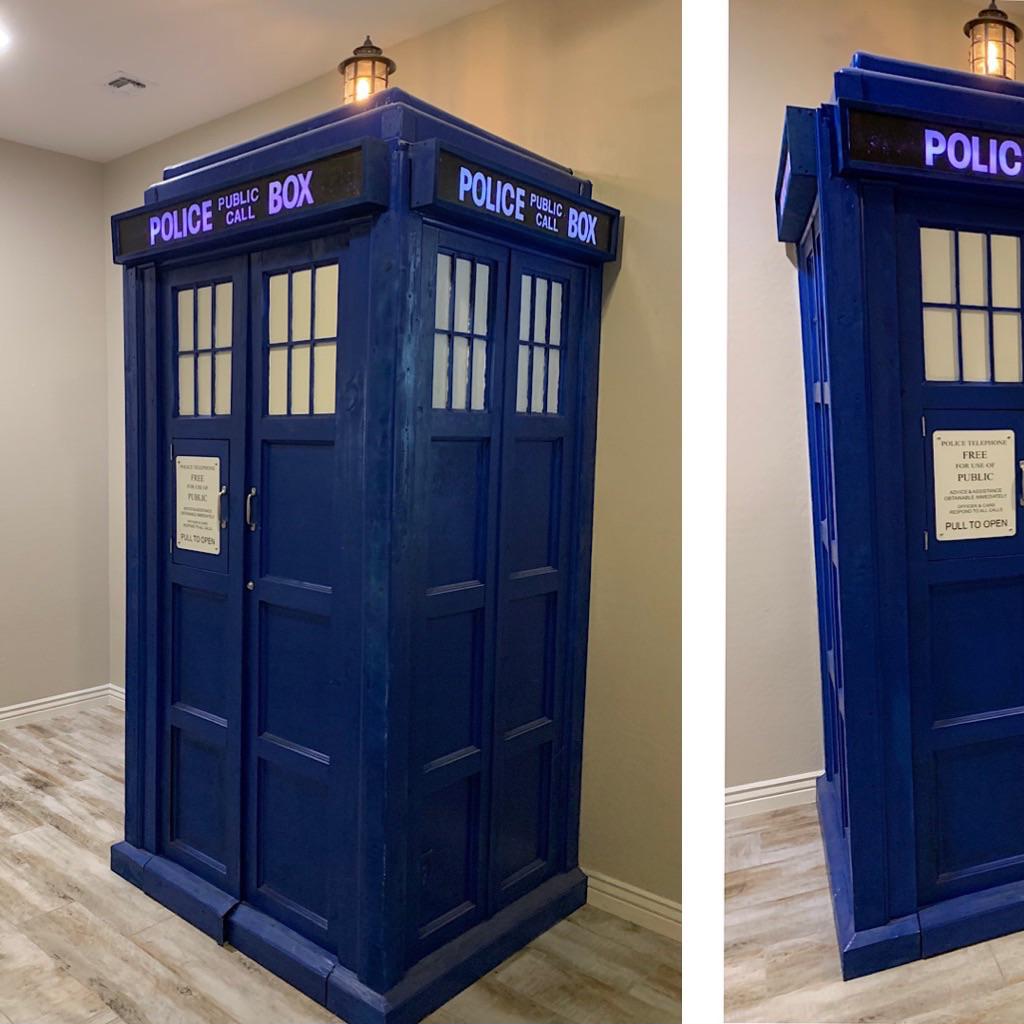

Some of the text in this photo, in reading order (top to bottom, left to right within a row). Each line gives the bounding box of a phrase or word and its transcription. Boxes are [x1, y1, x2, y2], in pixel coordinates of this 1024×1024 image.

[218, 188, 259, 211] PUBLIC
[269, 171, 314, 214] BOX
[459, 167, 526, 221] POLICE
[530, 194, 562, 216] PUBLIC
[150, 200, 213, 245] POLICE
[226, 207, 255, 224] CALL
[536, 213, 558, 232] CALL
[568, 208, 597, 245] BOX
[963, 451, 987, 459] FREE
[958, 473, 994, 481] PUBLIC
[945, 522, 967, 530] PULL
[983, 519, 1008, 528] OPEN
[180, 534, 192, 542] PULL
[201, 536, 215, 545] OPEN
